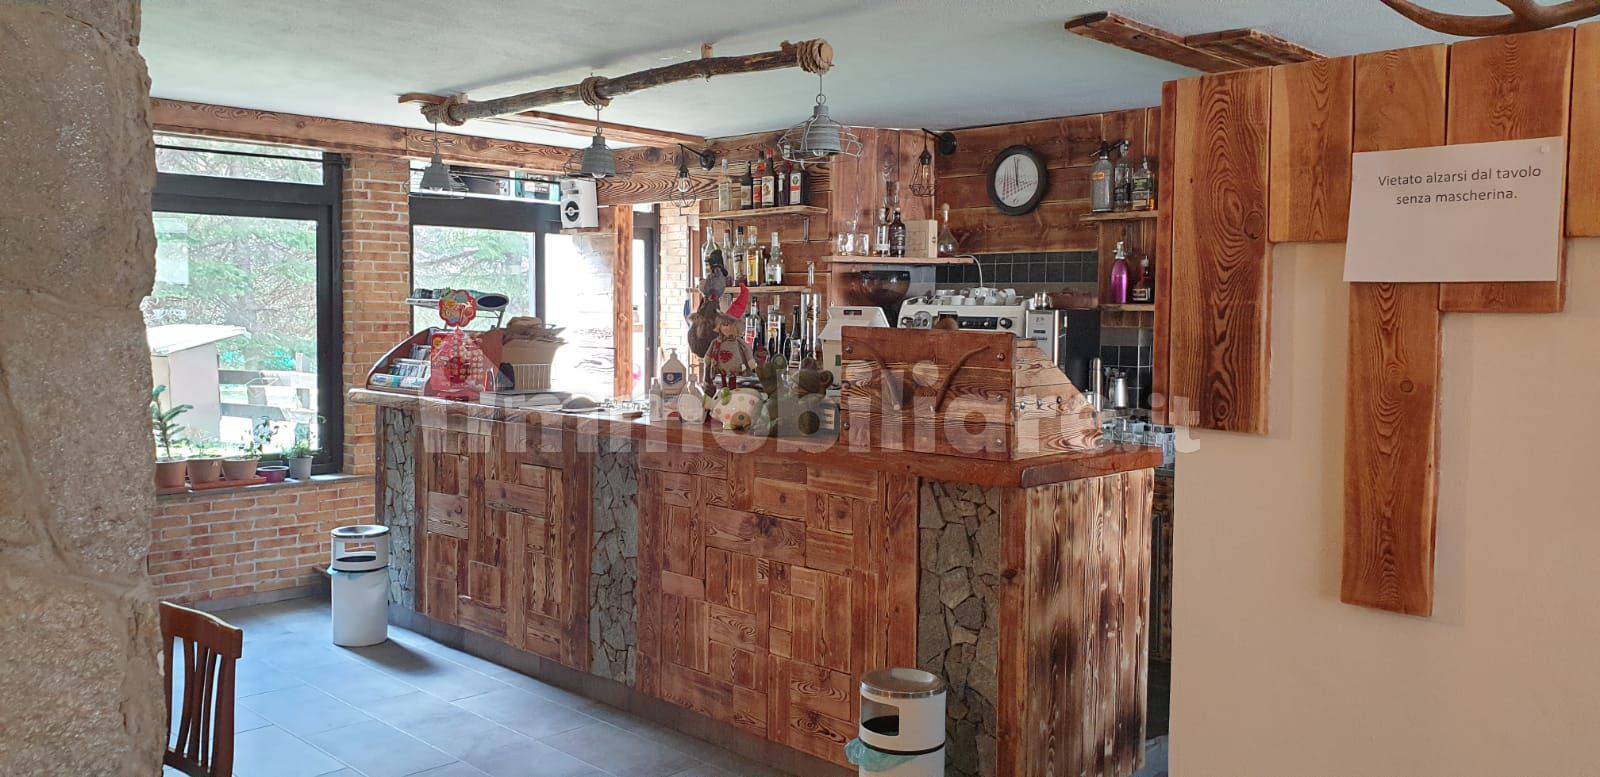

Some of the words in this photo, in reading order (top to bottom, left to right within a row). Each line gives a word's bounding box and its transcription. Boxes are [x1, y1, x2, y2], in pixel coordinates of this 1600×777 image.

[1378, 174, 1423, 187] Vietato
[1426, 170, 1468, 184] alzarsi
[1471, 168, 1492, 181] dal
[1496, 165, 1542, 180] tavolo
[1396, 194, 1431, 205] senza
[1435, 188, 1518, 204] mascherina.
